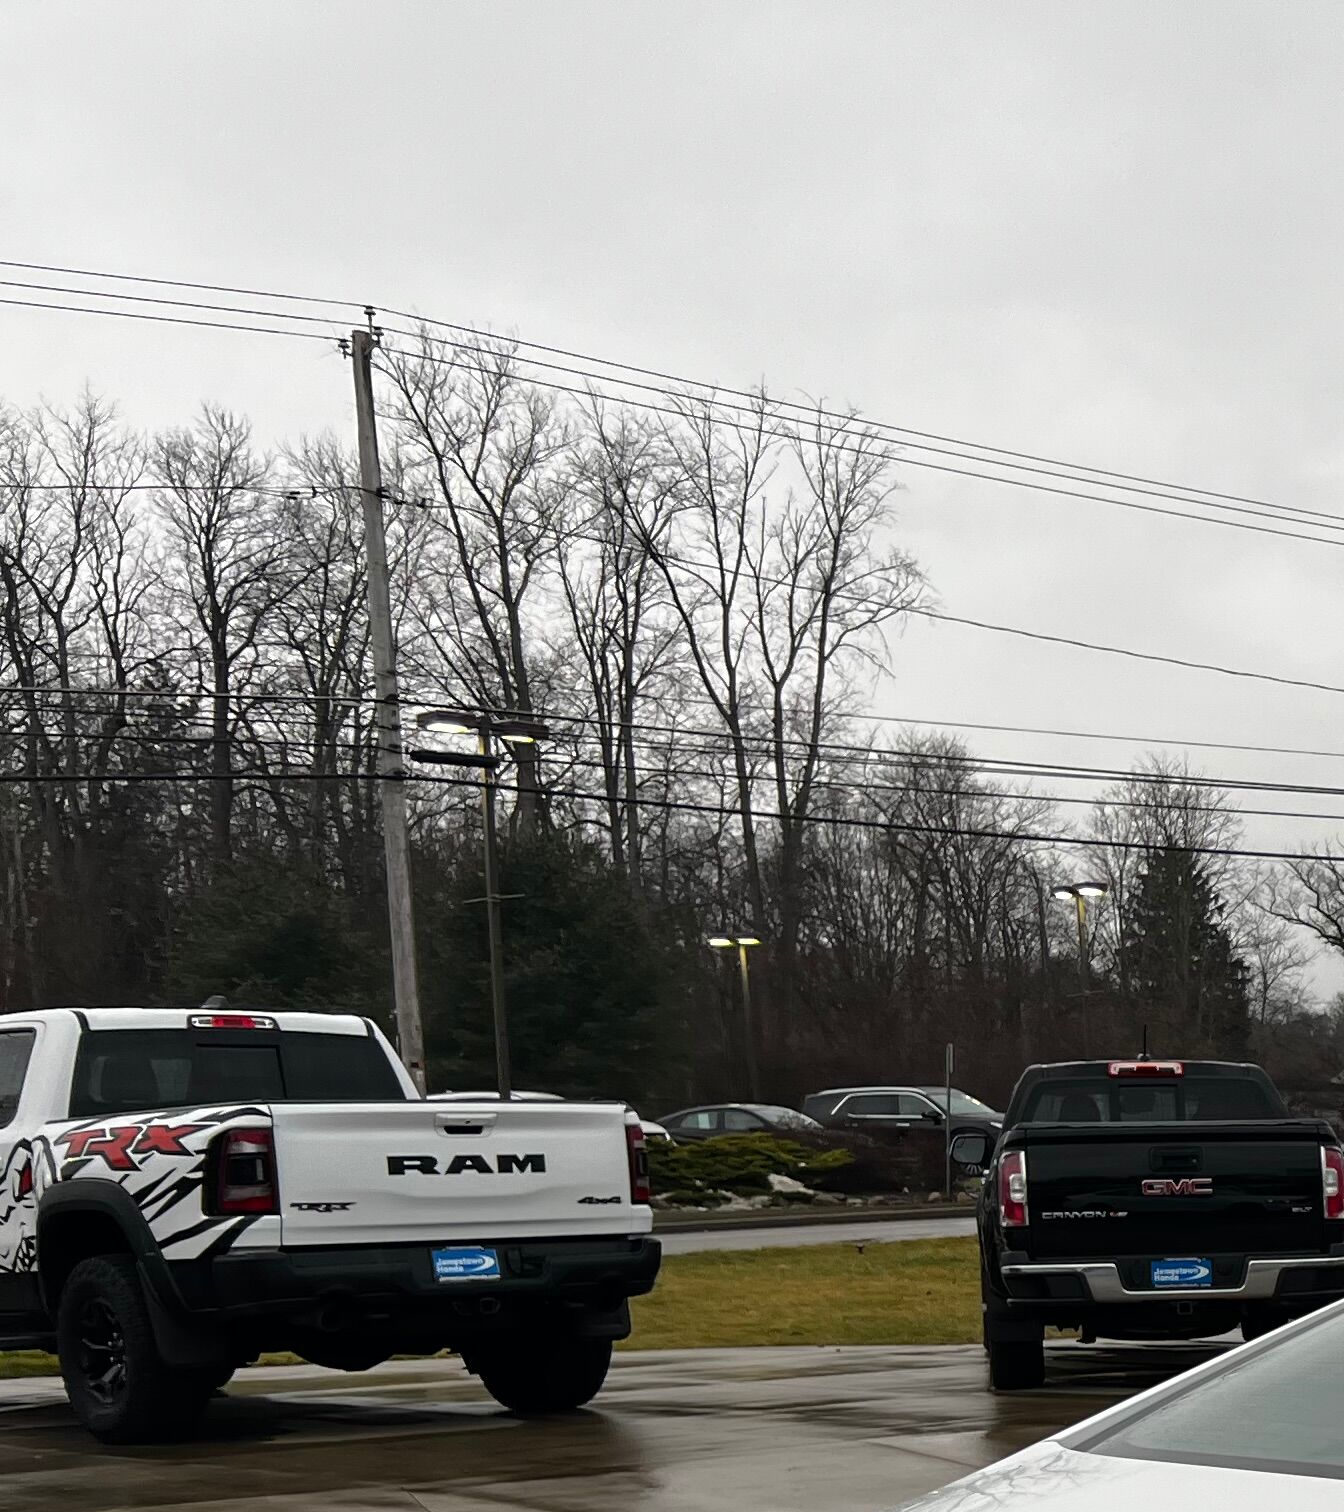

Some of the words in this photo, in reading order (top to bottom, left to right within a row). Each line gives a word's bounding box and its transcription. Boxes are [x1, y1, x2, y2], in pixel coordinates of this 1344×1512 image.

[54, 1124, 218, 1172] TRX
[386, 1153, 546, 1176] RAM
[1142, 1178, 1213, 1195] GMC
[1041, 1210, 1107, 1219] CANYON
